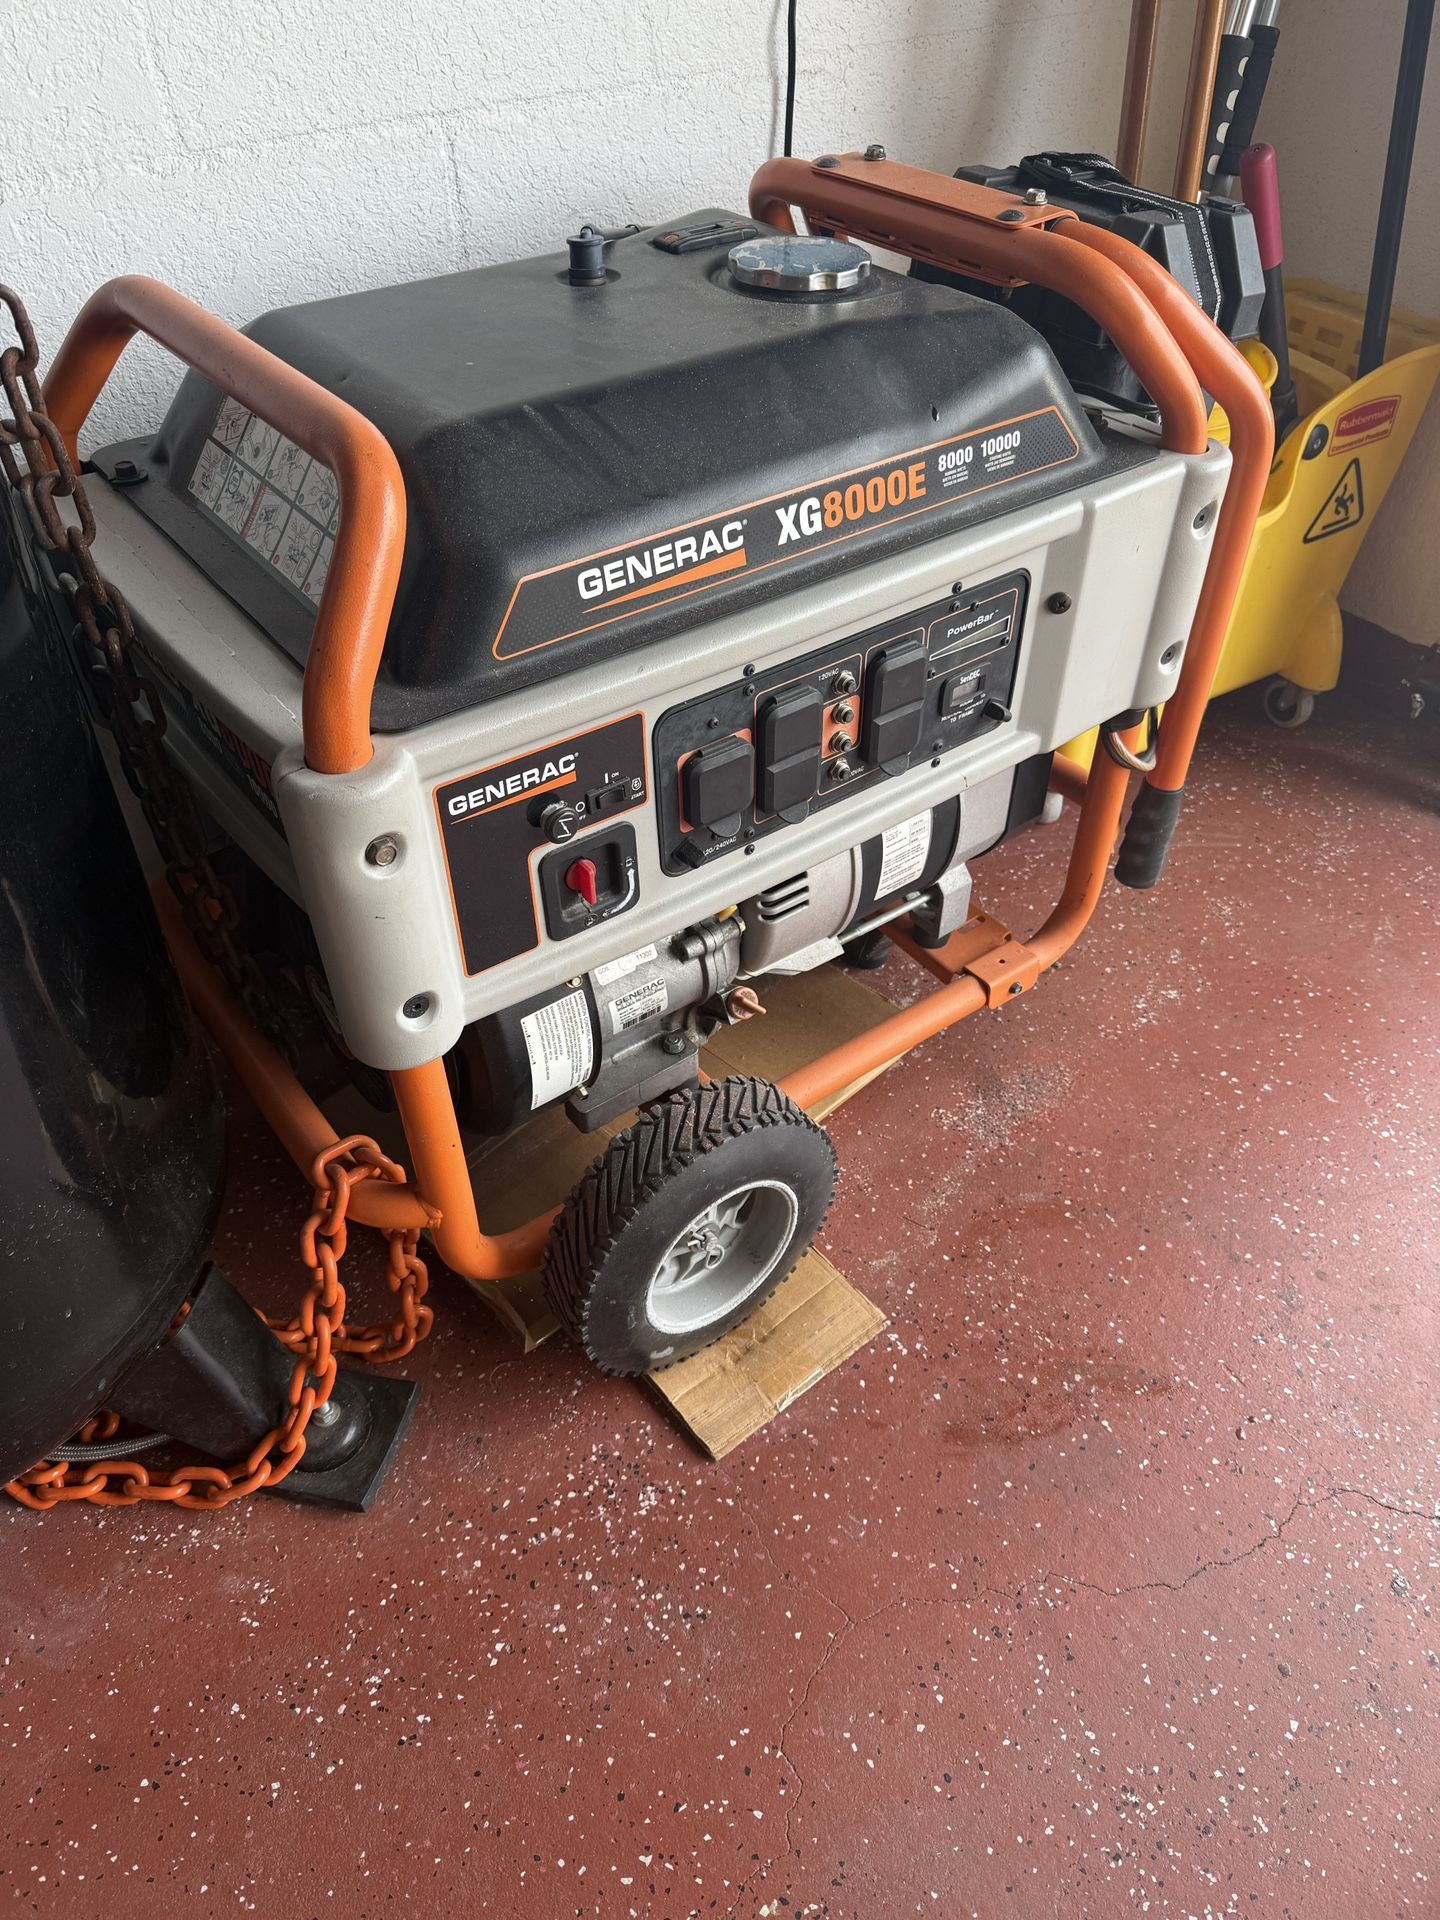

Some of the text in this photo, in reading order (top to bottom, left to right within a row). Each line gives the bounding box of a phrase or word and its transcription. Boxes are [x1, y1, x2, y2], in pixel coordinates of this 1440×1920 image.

[938, 446, 973, 472] 8000
[981, 431, 1021, 457] 10000
[775, 461, 927, 546] XG8000E
[577, 521, 745, 600] GENERAC
[947, 612, 994, 638] PowerBar
[960, 669, 981, 684] SenDEC
[448, 754, 576, 816] GENERAC
[614, 978, 665, 1008] GENERAC
